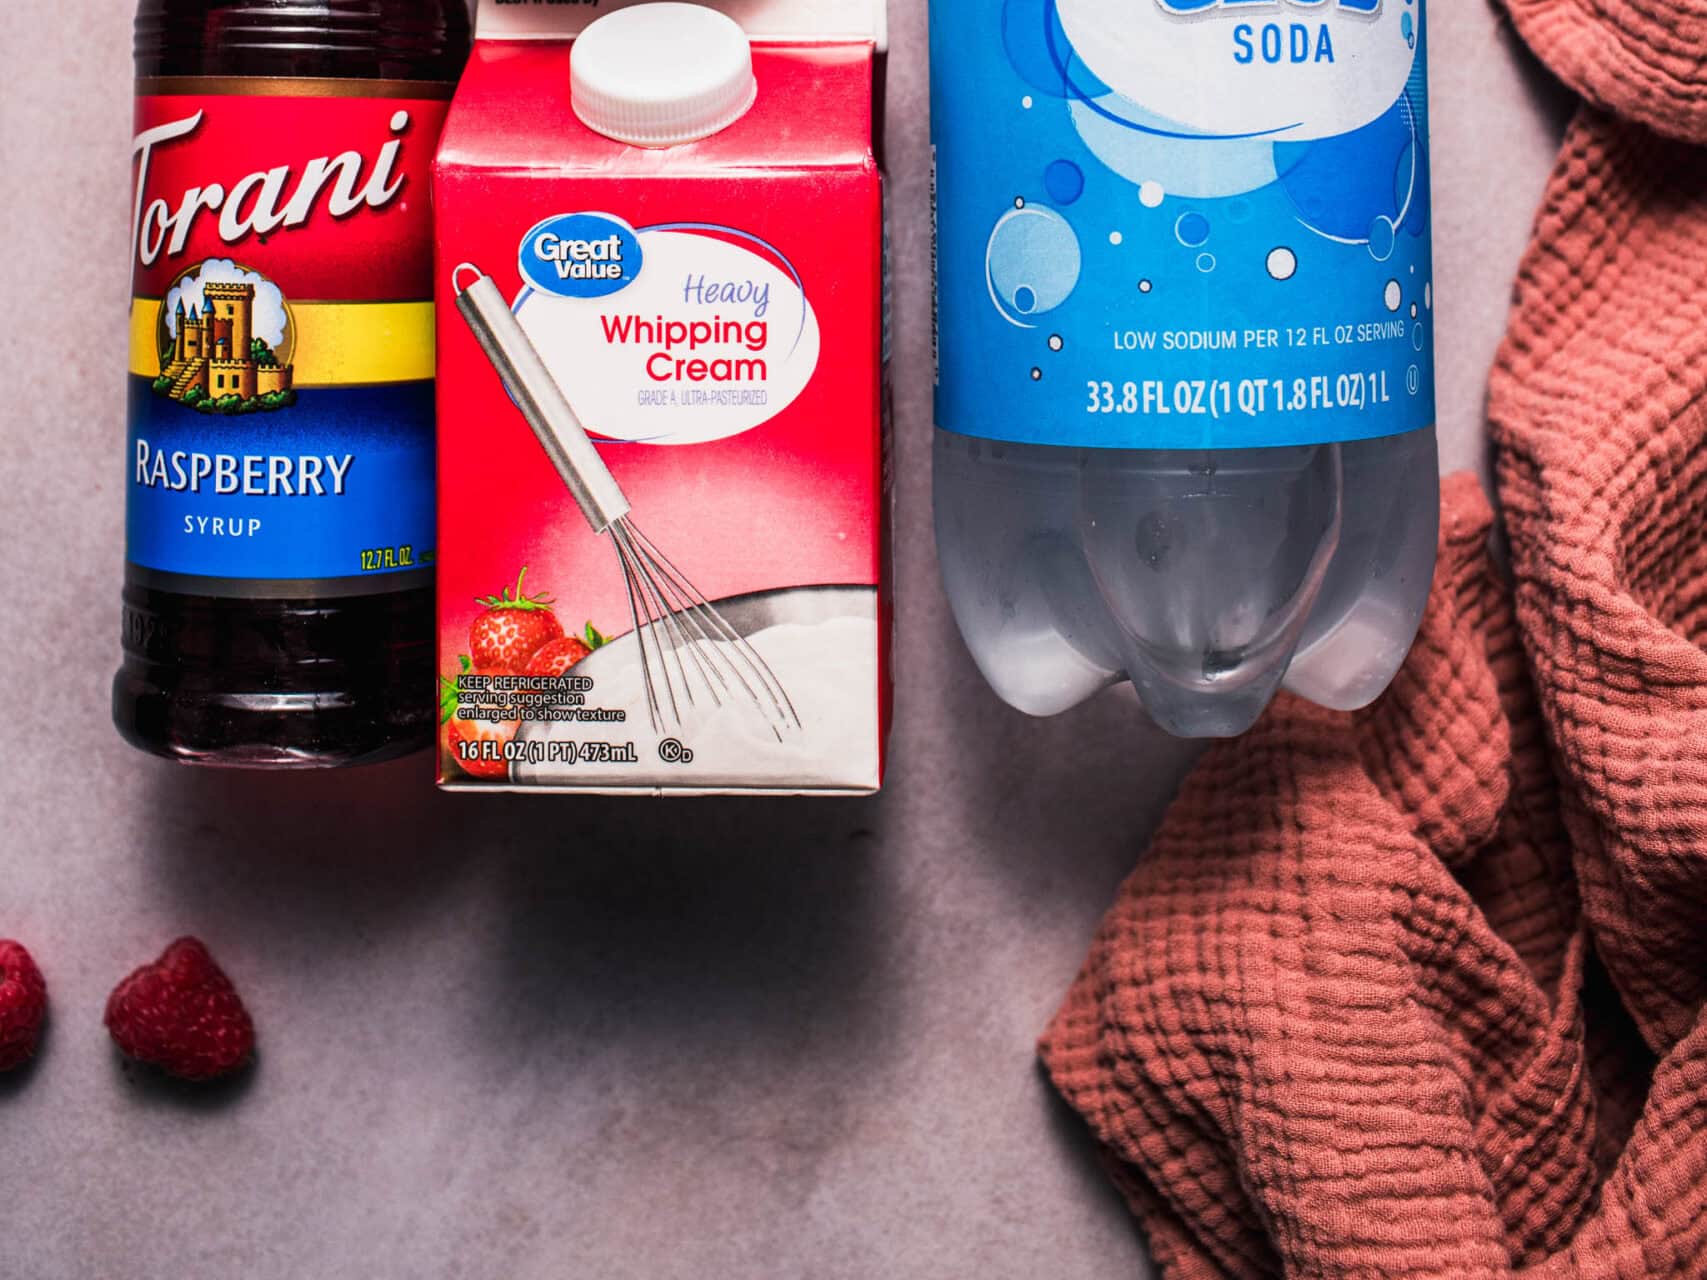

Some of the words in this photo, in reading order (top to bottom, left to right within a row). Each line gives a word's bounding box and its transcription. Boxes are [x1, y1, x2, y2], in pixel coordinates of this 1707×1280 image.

[1233, 24, 1335, 64] SODA
[130, 108, 409, 278] Torani
[534, 232, 622, 261] Great
[554, 259, 622, 279] Value
[683, 273, 770, 317] Heavy
[600, 315, 768, 351] Whipping
[1114, 331, 1156, 350] LOW
[1162, 331, 1237, 350] SODIUM
[1244, 329, 1278, 348] PER
[1287, 328, 1307, 347] 12
[1313, 328, 1329, 345] FL
[1334, 325, 1353, 343] OZ
[1357, 320, 1405, 342] SERVING
[645, 352, 767, 382] Cream
[638, 390, 668, 406] GRADE
[681, 390, 767, 406] ULTRA-PASTEURIZED
[1086, 381, 1138, 414] 33.8
[1142, 381, 1170, 414] FL
[1173, 380, 1206, 414] OZ
[1210, 380, 1231, 418] (1
[1237, 379, 1268, 416] QT
[1273, 378, 1307, 411] 1.8
[1311, 375, 1333, 409] FL
[1336, 372, 1365, 410] OZ)
[1369, 373, 1377, 404] 1
[1381, 371, 1390, 402] L
[136, 439, 353, 496] RASPBERRY
[184, 515, 262, 536] SYRUP
[361, 549, 383, 570] 12.7
[458, 676, 492, 690] KEEP
[494, 677, 593, 690] REFRIGERATED
[458, 691, 507, 706] serving
[509, 692, 584, 707] suggestion
[458, 706, 517, 723] enlarged
[520, 709, 535, 720] to
[537, 707, 574, 720] show
[576, 709, 626, 721] texture
[458, 742, 478, 761] 16
[483, 742, 500, 760] FL
[504, 742, 526, 761] OZ
[528, 741, 544, 764] (1
[548, 741, 578, 764] PT)
[579, 742, 637, 761] 473mL
